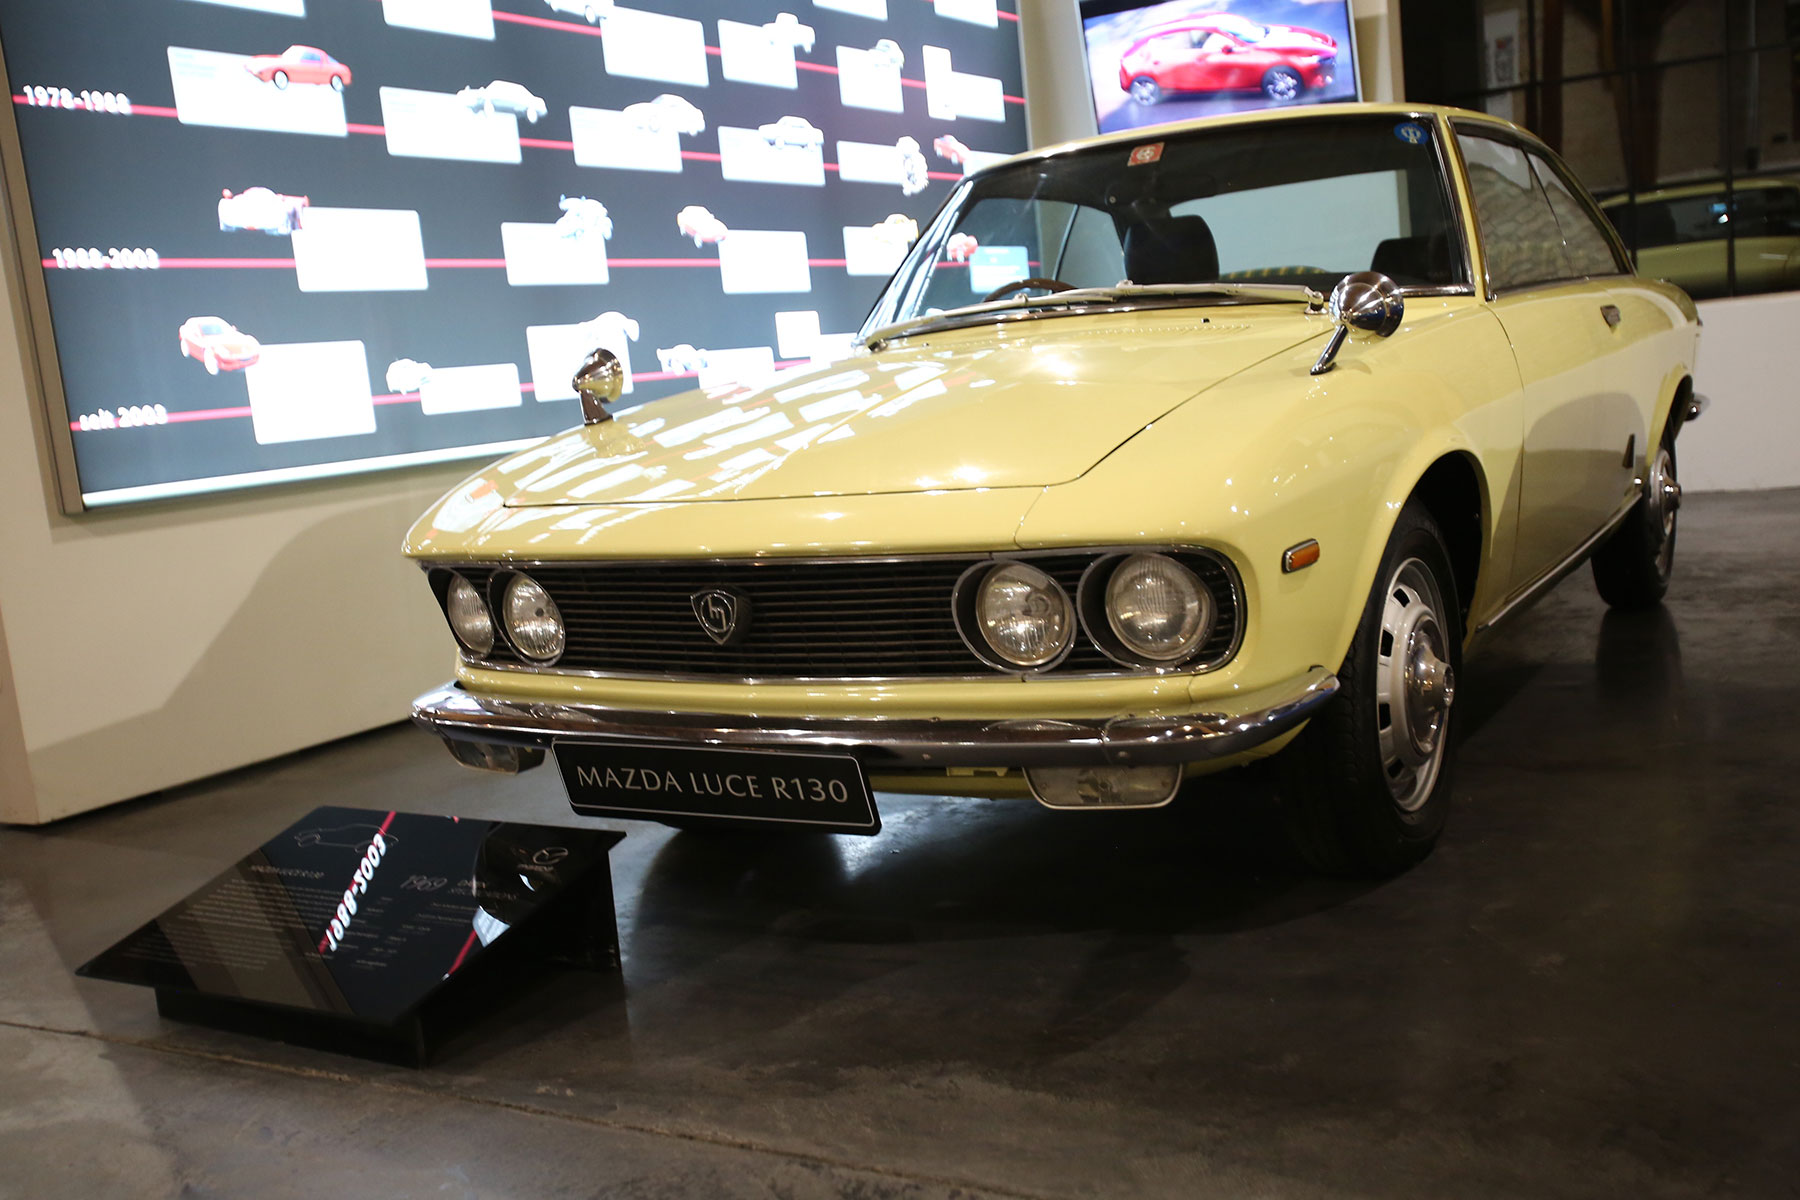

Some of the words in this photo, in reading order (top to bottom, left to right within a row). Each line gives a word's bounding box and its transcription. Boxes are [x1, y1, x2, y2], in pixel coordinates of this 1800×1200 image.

[23, 85, 132, 115] 1978-1988
[118, 403, 168, 428] 2003
[576, 765, 682, 793] MAZDA
[689, 772, 763, 798] LUCE
[771, 776, 848, 803] R130
